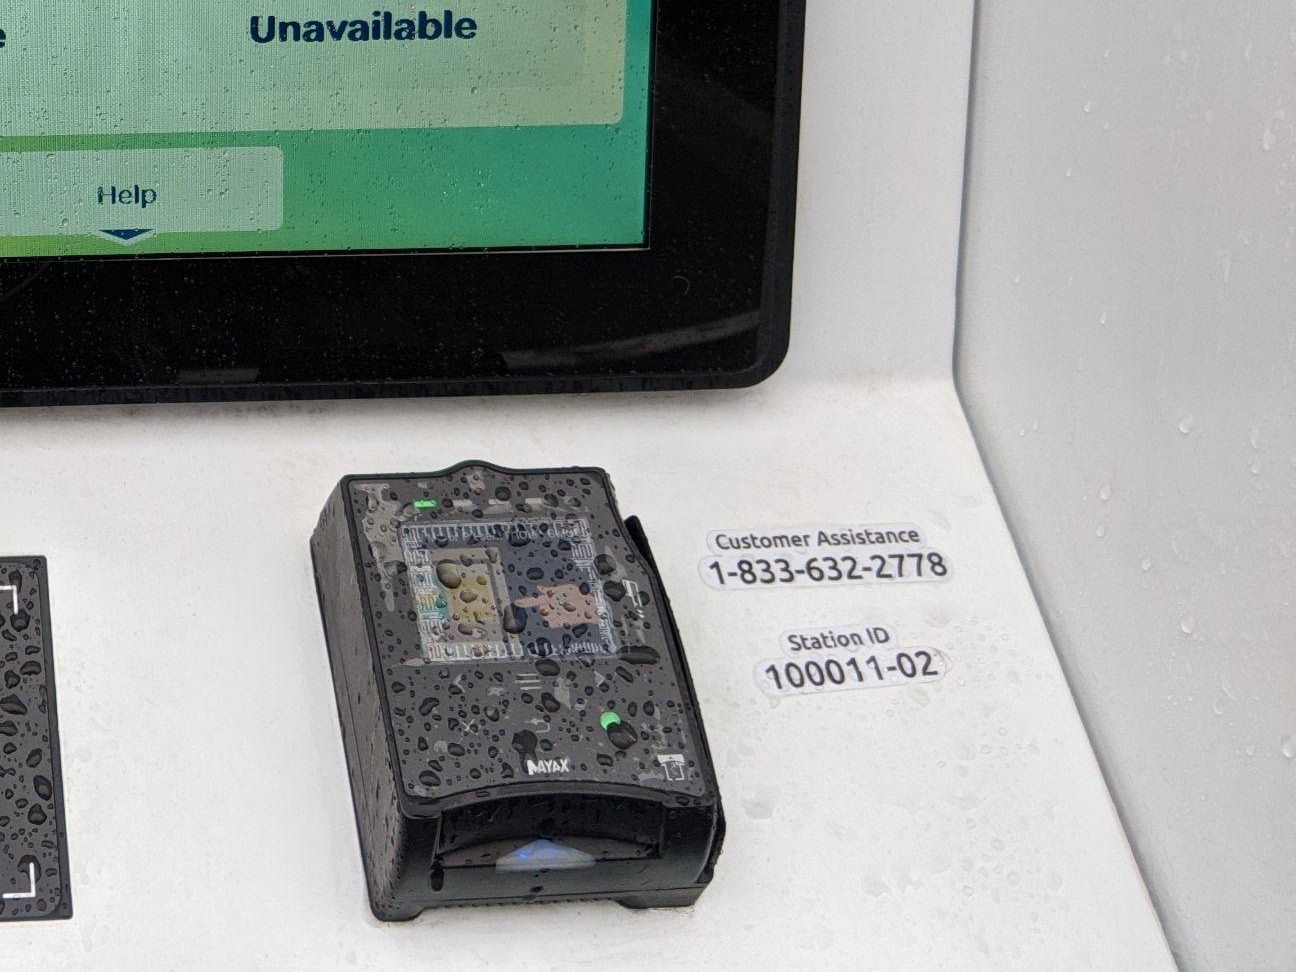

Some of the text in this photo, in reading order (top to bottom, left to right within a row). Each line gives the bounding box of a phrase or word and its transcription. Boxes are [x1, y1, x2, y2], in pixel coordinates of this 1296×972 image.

[250, 10, 477, 45] Unavailable
[97, 184, 157, 209] Help
[715, 528, 920, 551] Customer Assistance
[708, 551, 948, 585] 1-833-632-2778
[787, 627, 890, 652] Station ID
[765, 650, 938, 690] 100011-02
